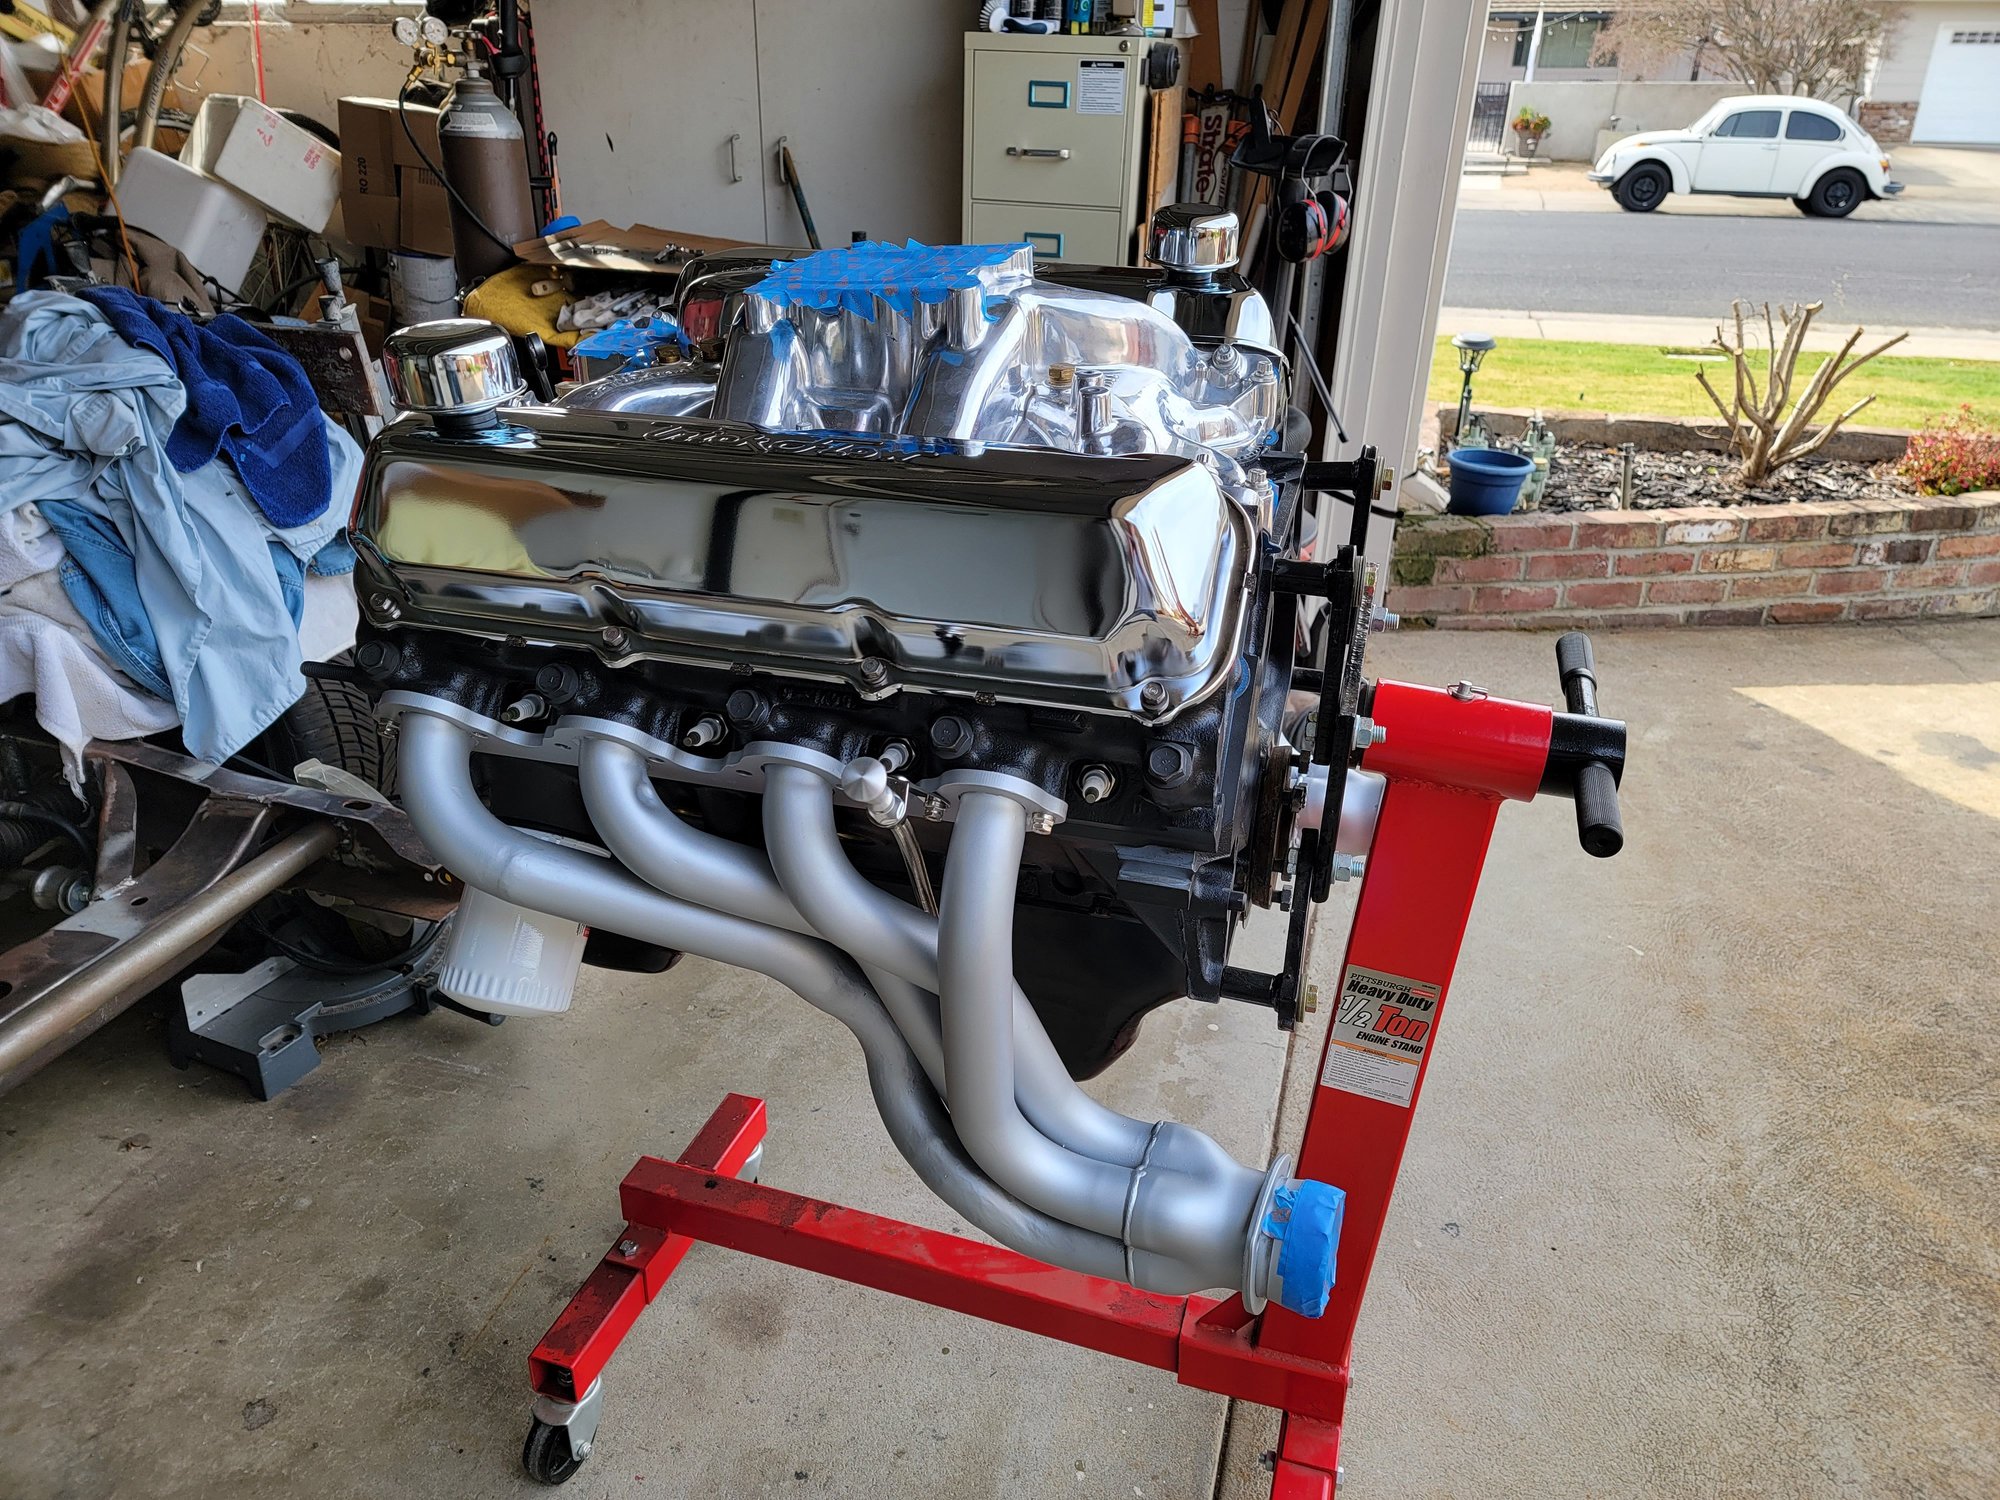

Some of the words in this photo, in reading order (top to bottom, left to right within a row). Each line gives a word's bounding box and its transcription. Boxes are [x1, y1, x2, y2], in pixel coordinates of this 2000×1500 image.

[358, 156, 368, 176] 220
[1350, 973, 1412, 992] PITTSBURGH
[1346, 980, 1398, 1002] Heavy
[1395, 992, 1434, 1012] Duty
[1372, 1004, 1429, 1042] Ton
[1356, 1031, 1390, 1047] ENGINE
[1391, 1040, 1424, 1055] STAND
